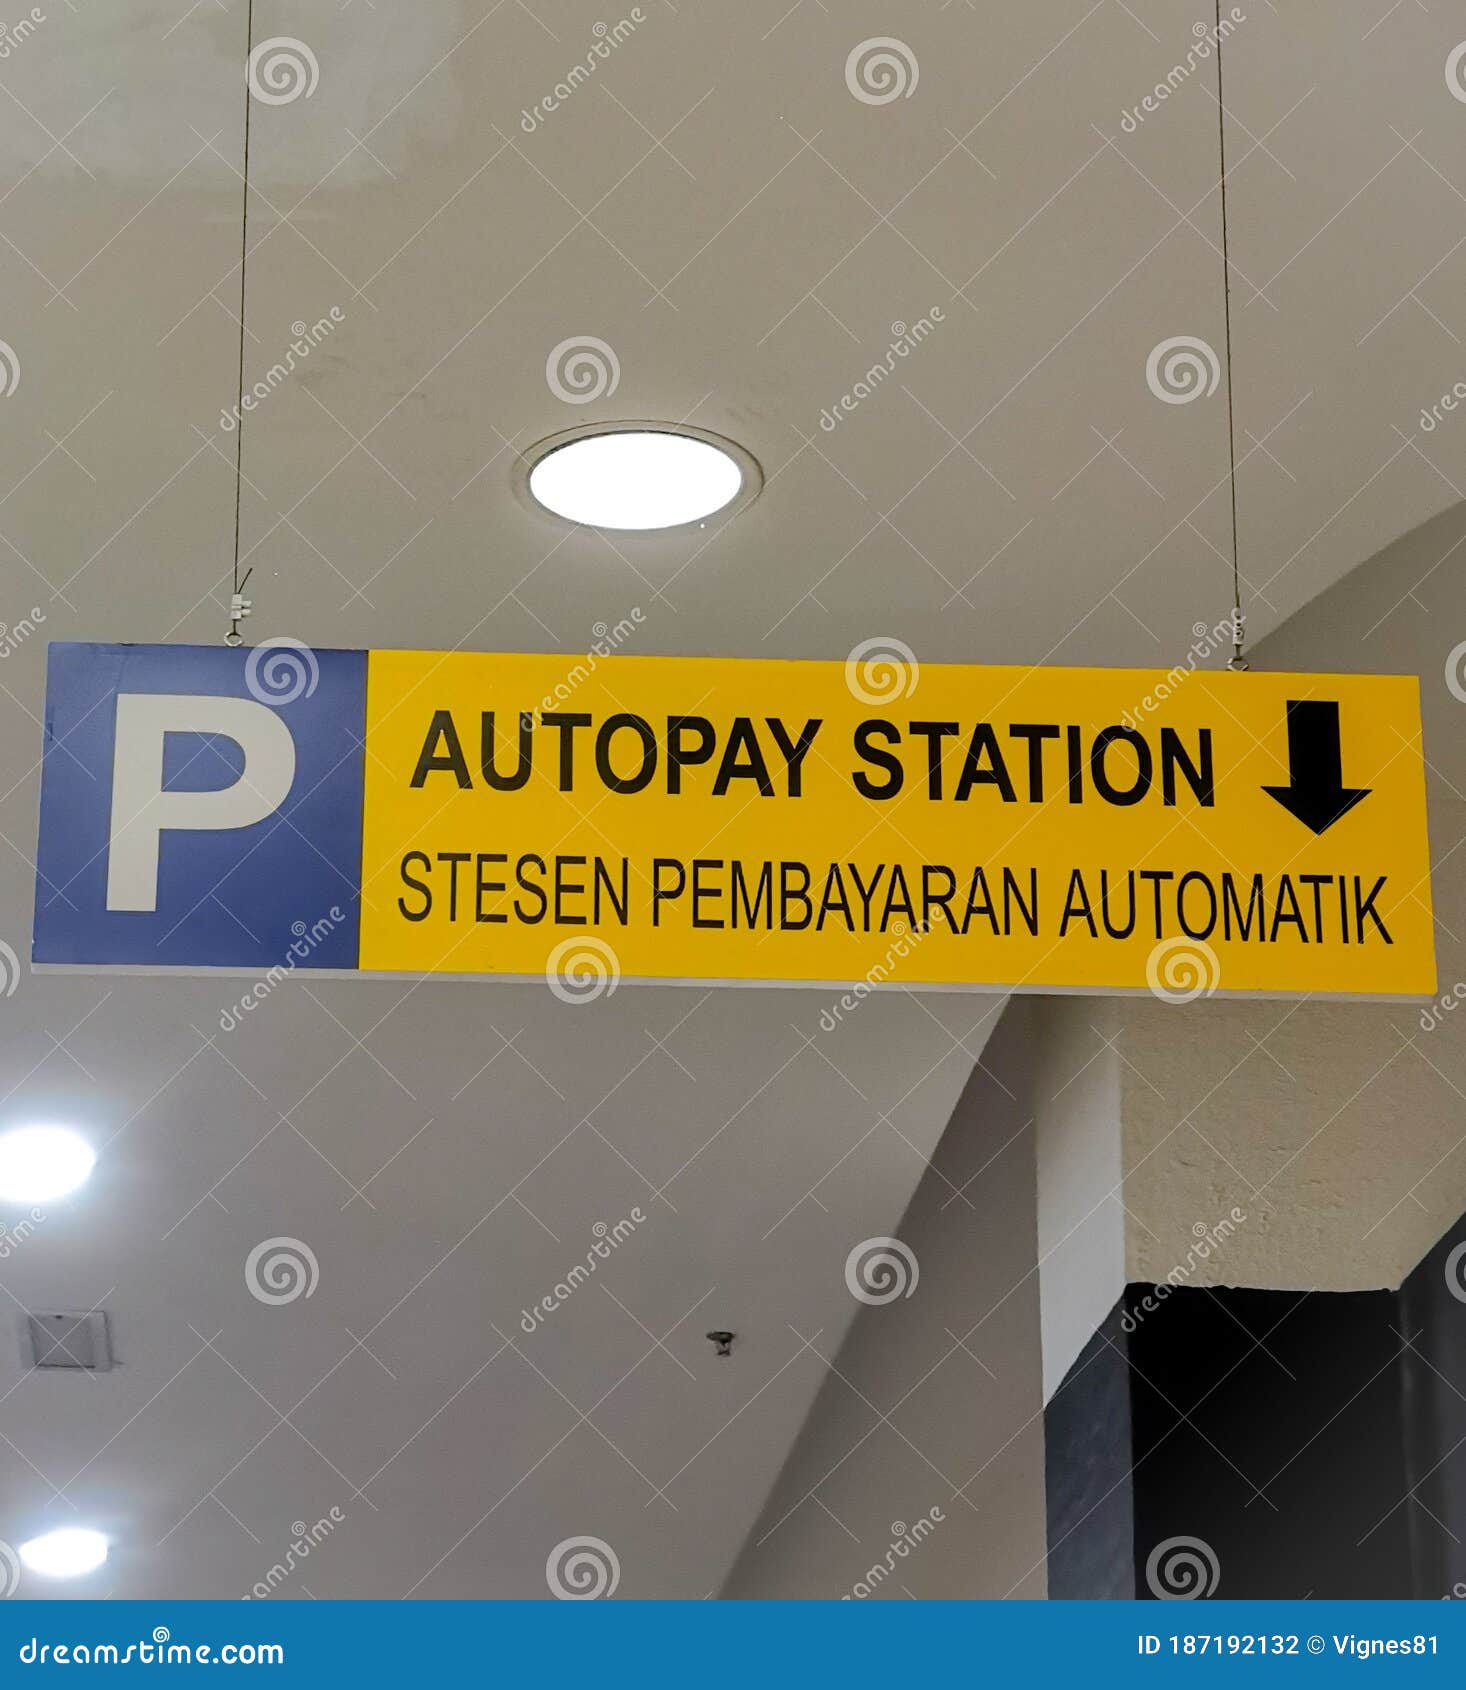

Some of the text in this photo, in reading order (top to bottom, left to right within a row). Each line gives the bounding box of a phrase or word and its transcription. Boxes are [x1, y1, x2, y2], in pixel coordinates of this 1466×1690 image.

[106, 693, 296, 912] P
[410, 710, 1215, 808] AUTOPAY STATION
[398, 850, 1394, 945] STESEN PEMBAYARAN AUTOMATIK
